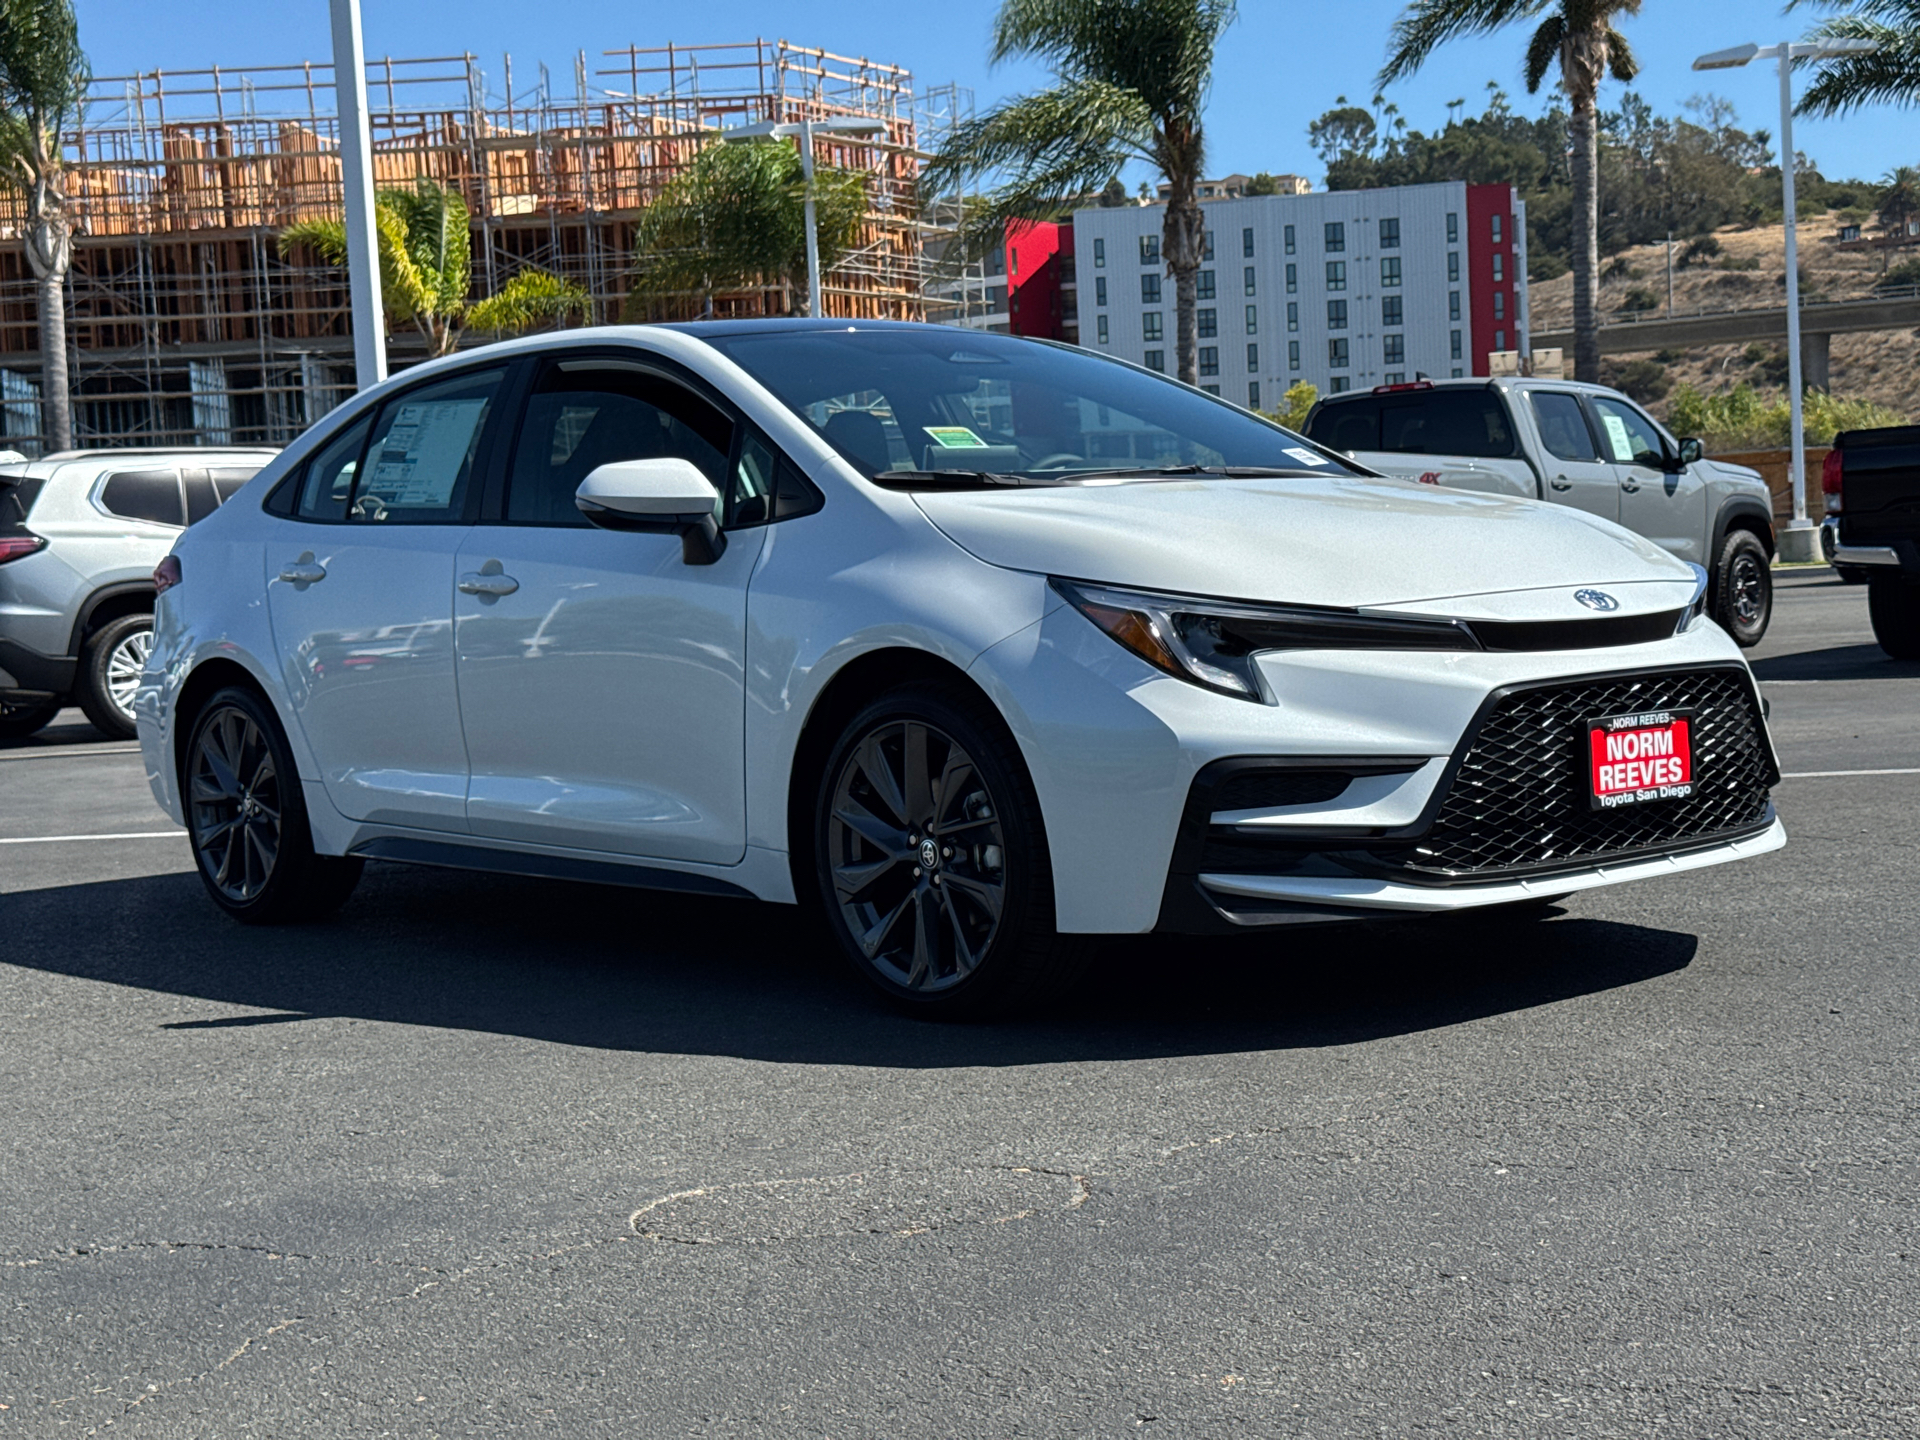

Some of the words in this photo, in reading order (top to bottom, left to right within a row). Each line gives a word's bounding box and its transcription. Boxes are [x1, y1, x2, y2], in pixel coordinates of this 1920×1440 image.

[1612, 716, 1638, 729] NORM
[1639, 712, 1670, 725] REEVES
[1606, 730, 1674, 762] NORM
[1599, 756, 1683, 791] REEVES
[1599, 793, 1634, 808] Toyota
[1636, 788, 1658, 802] San
[1660, 785, 1692, 799] Diego
